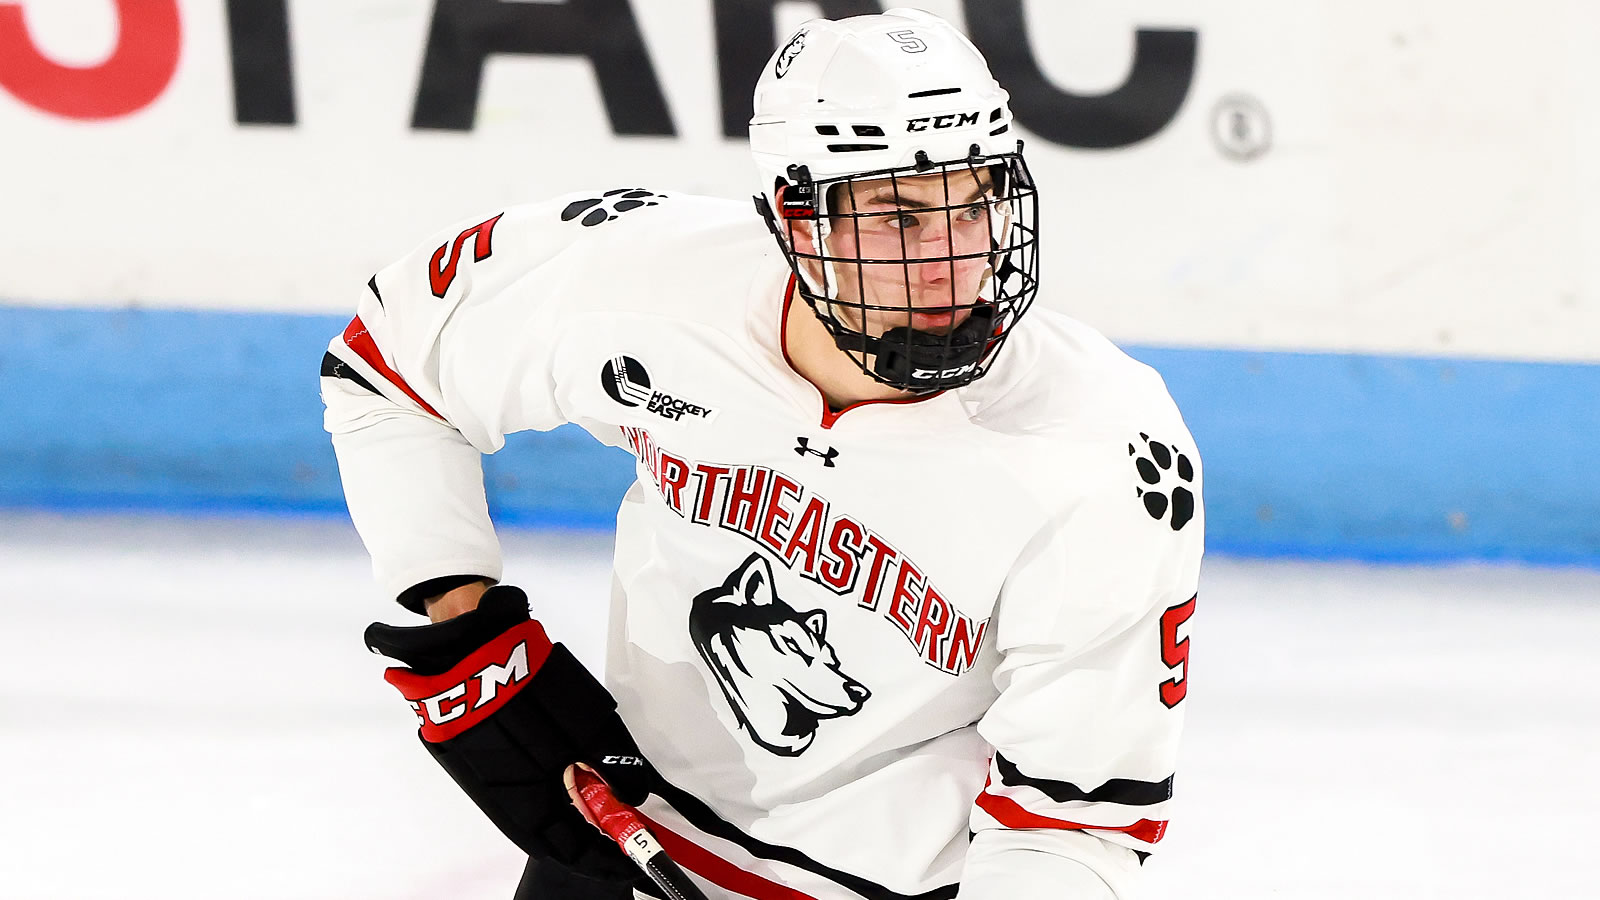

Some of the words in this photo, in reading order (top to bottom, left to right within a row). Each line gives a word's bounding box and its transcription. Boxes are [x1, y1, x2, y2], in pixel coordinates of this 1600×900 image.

[886, 29, 928, 54] 5
[906, 111, 980, 132] CCM
[428, 212, 504, 299] 5
[911, 361, 977, 379] CCM
[646, 400, 686, 422] EAST
[650, 390, 712, 418] HOCKEY
[1159, 591, 1198, 709] 5
